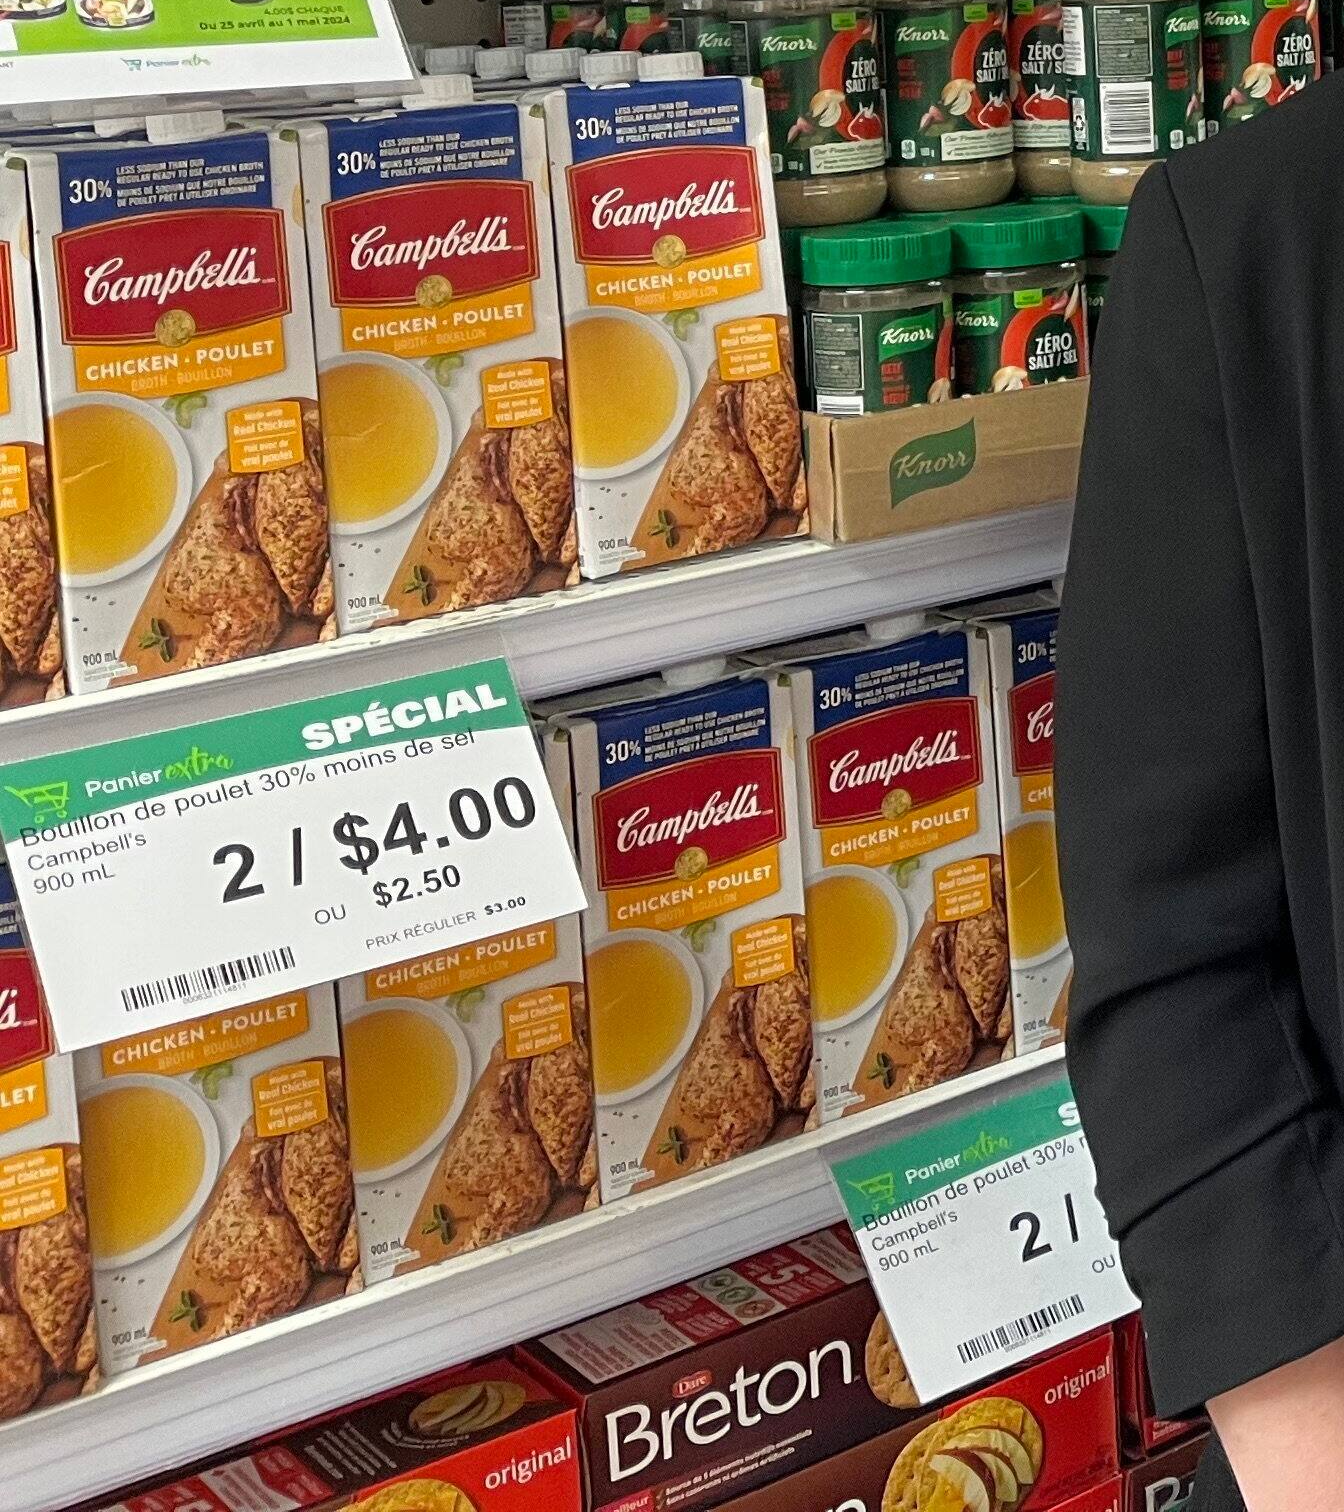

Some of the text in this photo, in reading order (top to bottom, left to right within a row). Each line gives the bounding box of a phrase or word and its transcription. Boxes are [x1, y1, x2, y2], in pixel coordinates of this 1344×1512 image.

[199, 21, 217, 30] Du
[220, 20, 235, 30] 25
[237, 19, 266, 29] avril
[268, 19, 284, 27] au
[297, 16, 320, 26] mai
[323, 16, 351, 26] 2024
[296, 5, 345, 15] CHAQUE
[1204, 9, 1250, 27] Knorr
[761, 34, 818, 55] Knorr
[1277, 52, 1302, 68] SALT
[1283, 33, 1312, 54] ZÉRO
[575, 117, 612, 140] 30%
[336, 150, 377, 177] 30%
[68, 178, 113, 204] 30%
[591, 180, 740, 231] Campbell's
[349, 216, 513, 271] Campbell's
[84, 246, 261, 306] Campbell's
[595, 262, 752, 297] CHICKEN POULET
[351, 302, 525, 343] CHICKEN POULET
[86, 340, 274, 381] CHICKEN POULET
[1029, 355, 1054, 371] SALT
[1034, 333, 1072, 355] ZÉRO
[895, 450, 969, 479] Knorr
[301, 683, 509, 752] SPÉCIAL
[84, 745, 235, 798] Panier extra
[605, 740, 641, 765] 30%
[829, 730, 961, 793] Campbell's
[19, 727, 476, 846] Bouillon de poulet 30% moins de sel
[617, 783, 763, 853] Campbell's
[27, 831, 148, 873] Campbell's
[213, 775, 537, 904] 2 / $4.00
[33, 862, 115, 896] 900 mL
[313, 863, 462, 926] OU $2.50
[365, 896, 527, 950] PRIX RÉGULIER $3.00
[862, 1140, 1075, 1233] Bouillon de poulet 30%
[904, 1152, 961, 1184] Panier
[871, 1211, 958, 1252] Campbell's
[1009, 1211, 1053, 1263] 2
[878, 1238, 940, 1271] 900 mL
[1091, 1255, 1117, 1274] OU
[1043, 1355, 1113, 1405] original
[603, 1339, 854, 1483] Breton
[483, 1434, 573, 1491] original
